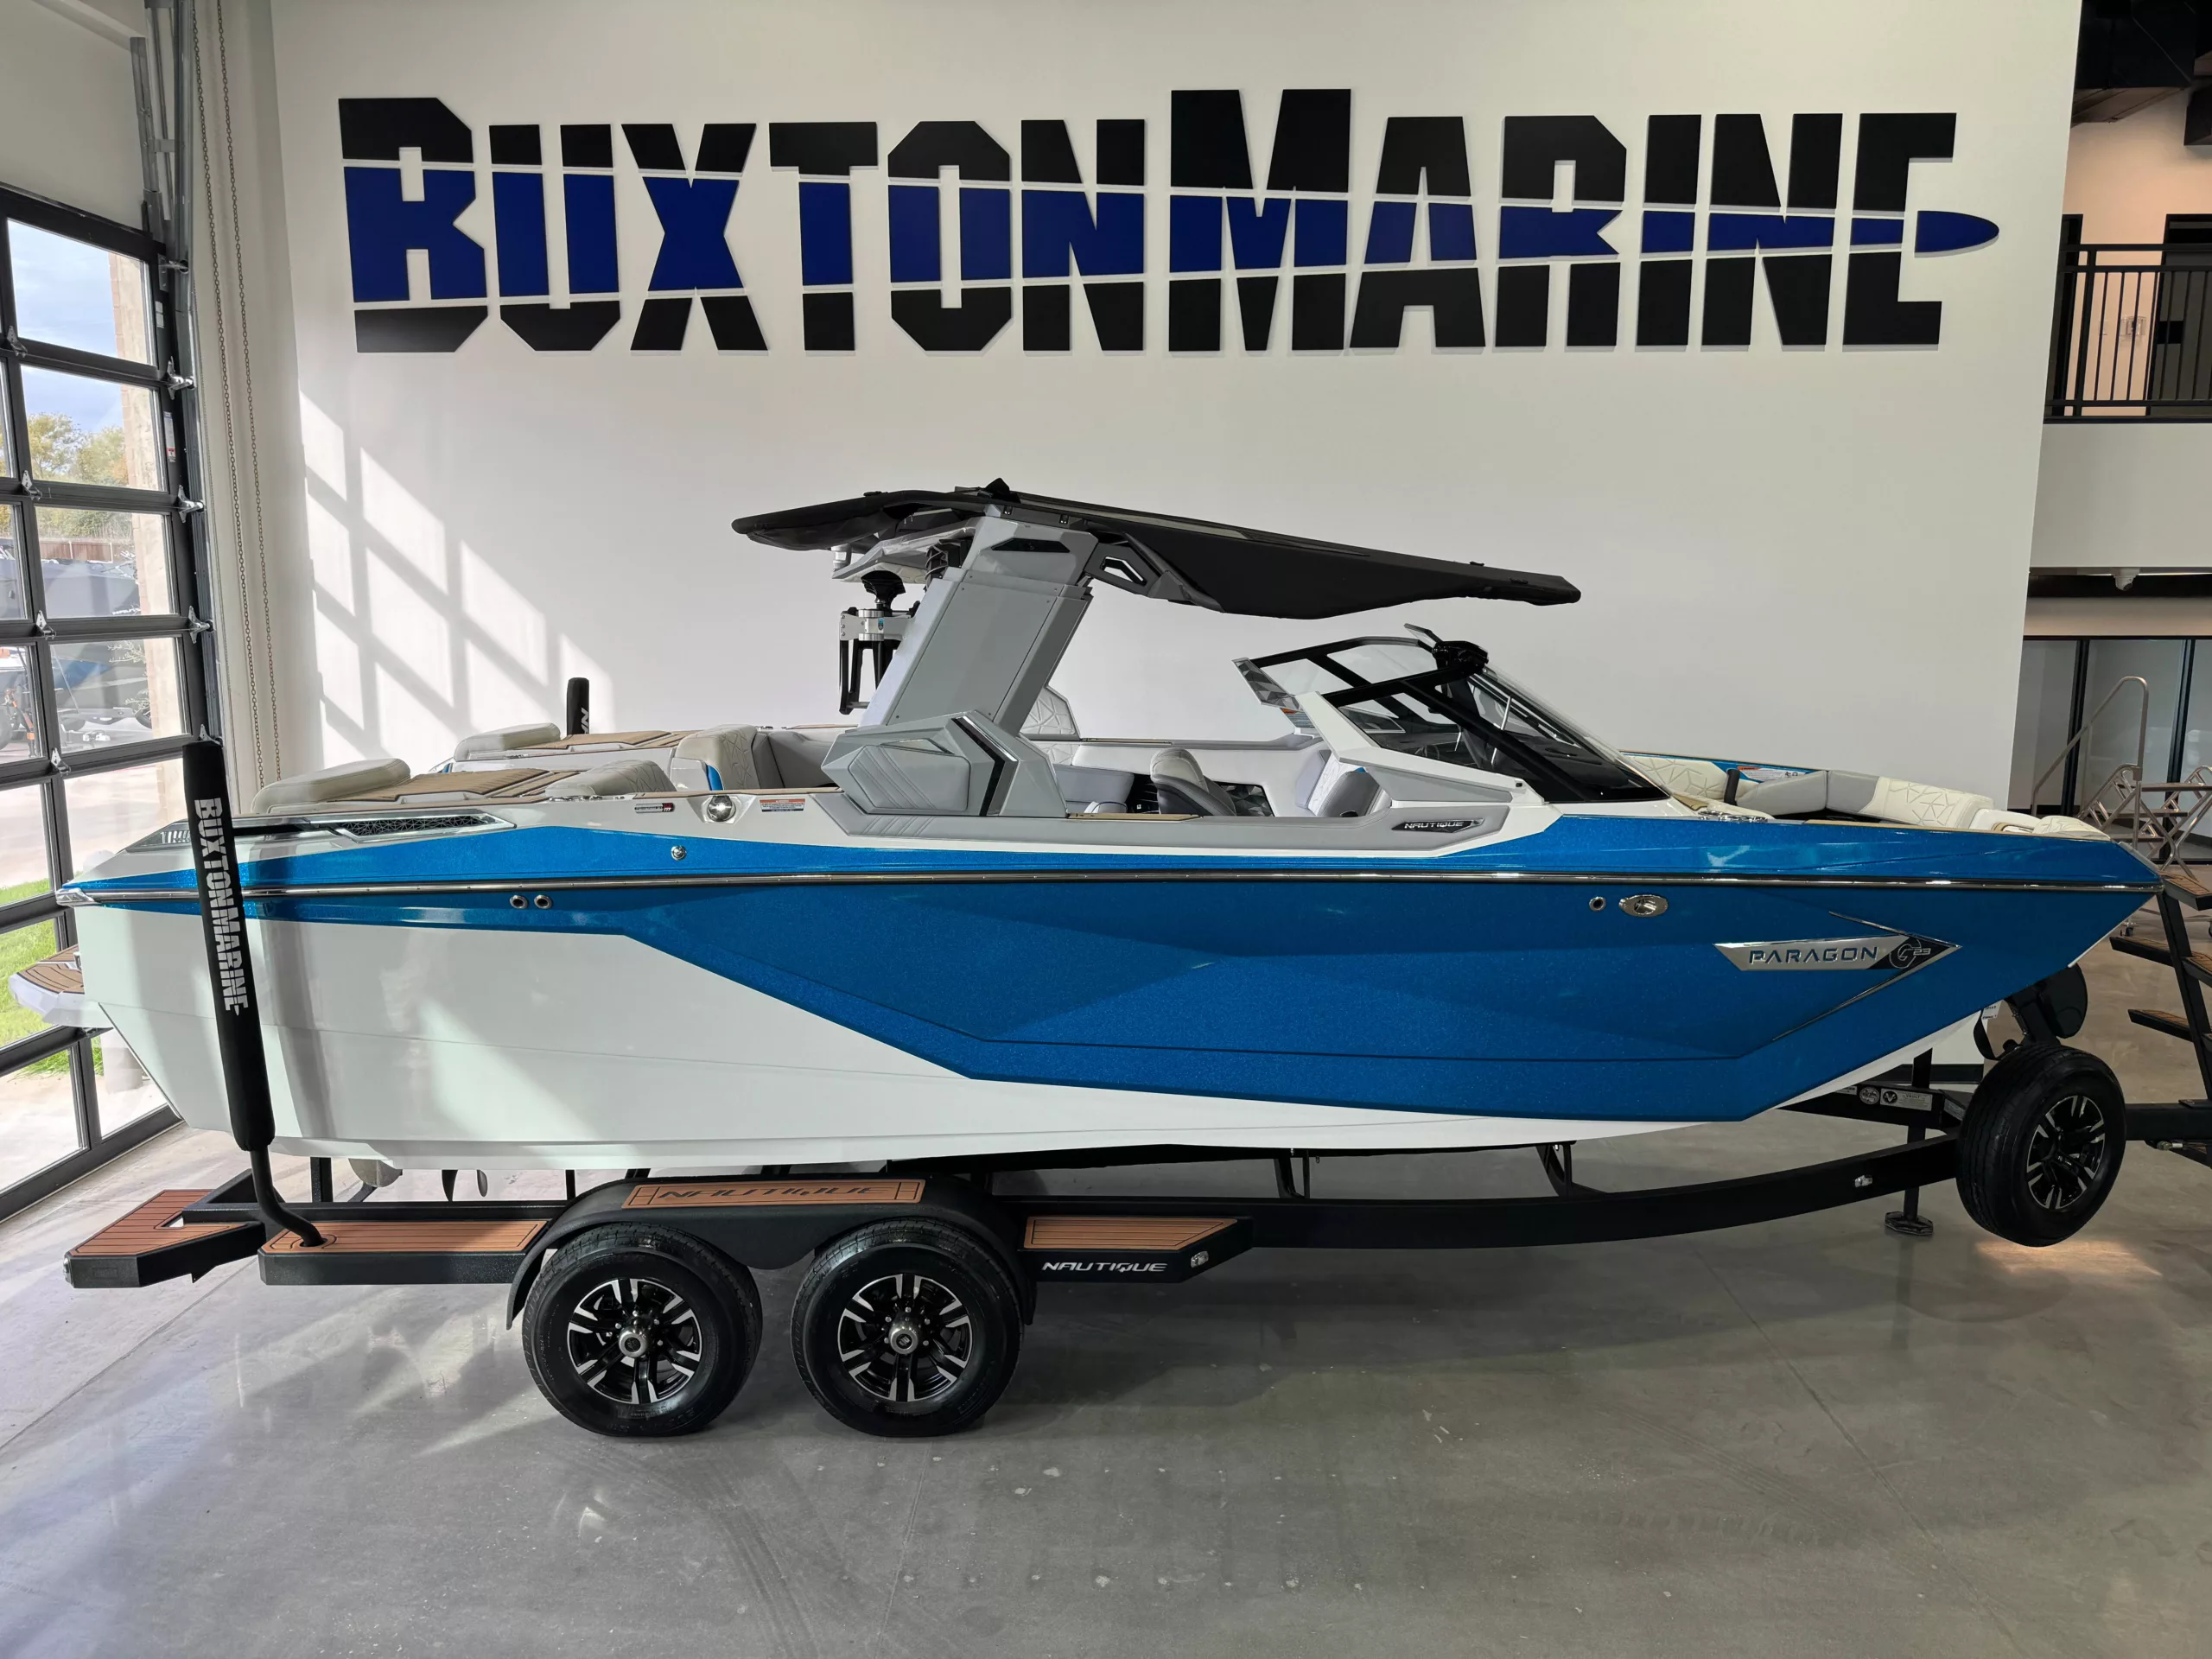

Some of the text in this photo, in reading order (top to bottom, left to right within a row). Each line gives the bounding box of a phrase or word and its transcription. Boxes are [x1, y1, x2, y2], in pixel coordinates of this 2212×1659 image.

[1749, 946, 1879, 965] PARAGON
[658, 1186, 893, 1199] NAUTIQUE
[1041, 1262, 1167, 1273] NAUTIQUE
